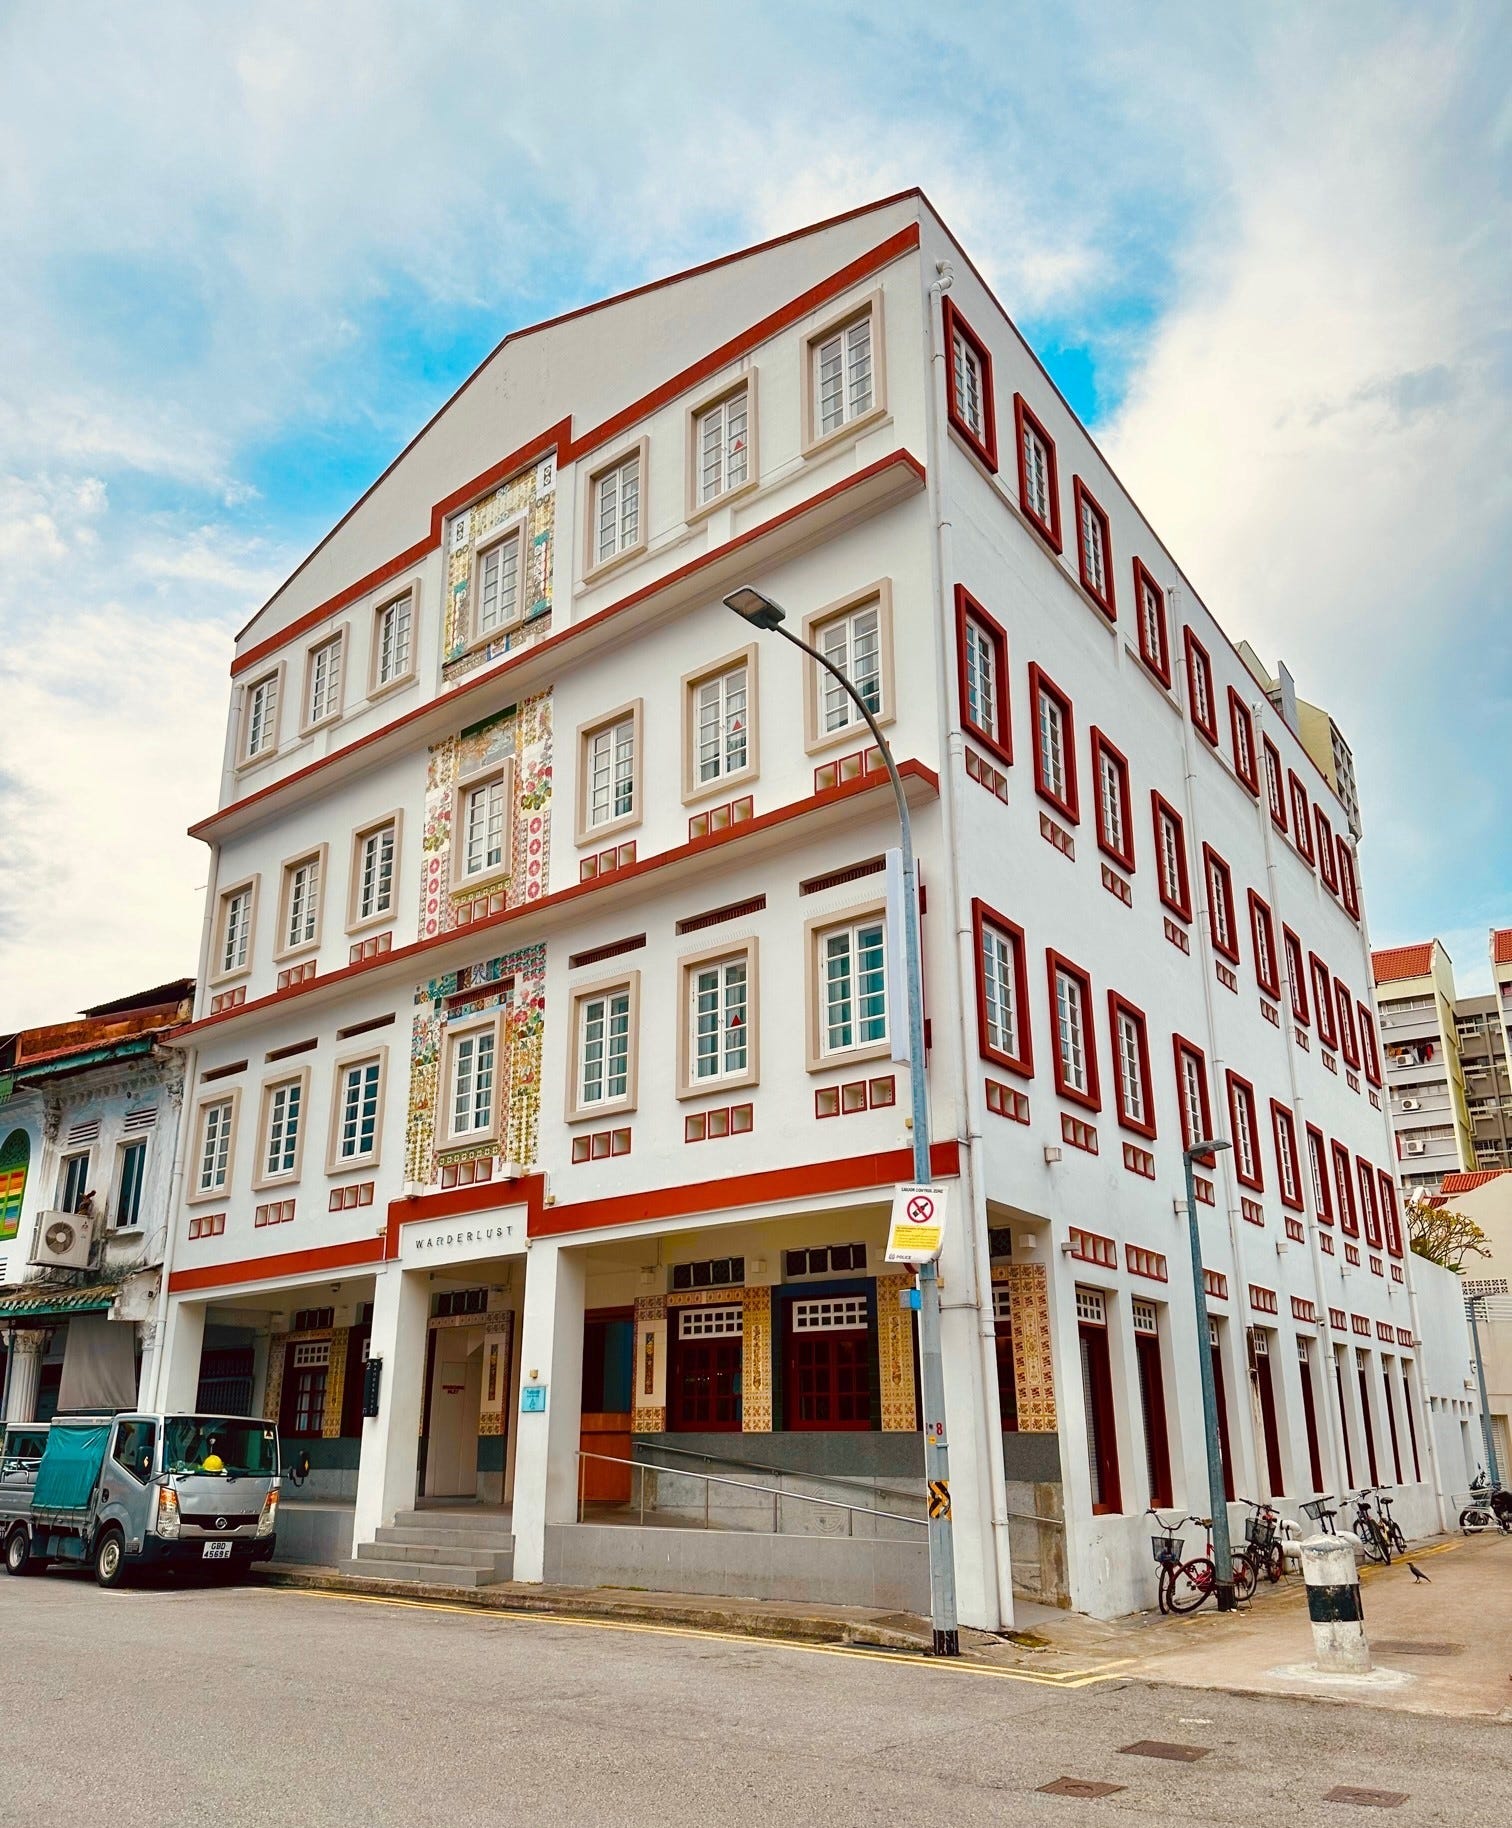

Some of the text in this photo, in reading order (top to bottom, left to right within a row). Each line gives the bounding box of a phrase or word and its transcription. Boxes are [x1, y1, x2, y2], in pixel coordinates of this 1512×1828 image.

[415, 1225, 513, 1249] WANDERLUST
[936, 1422, 943, 1435] 8
[211, 1542, 226, 1550] GBD
[203, 1550, 230, 1558] 4569E
